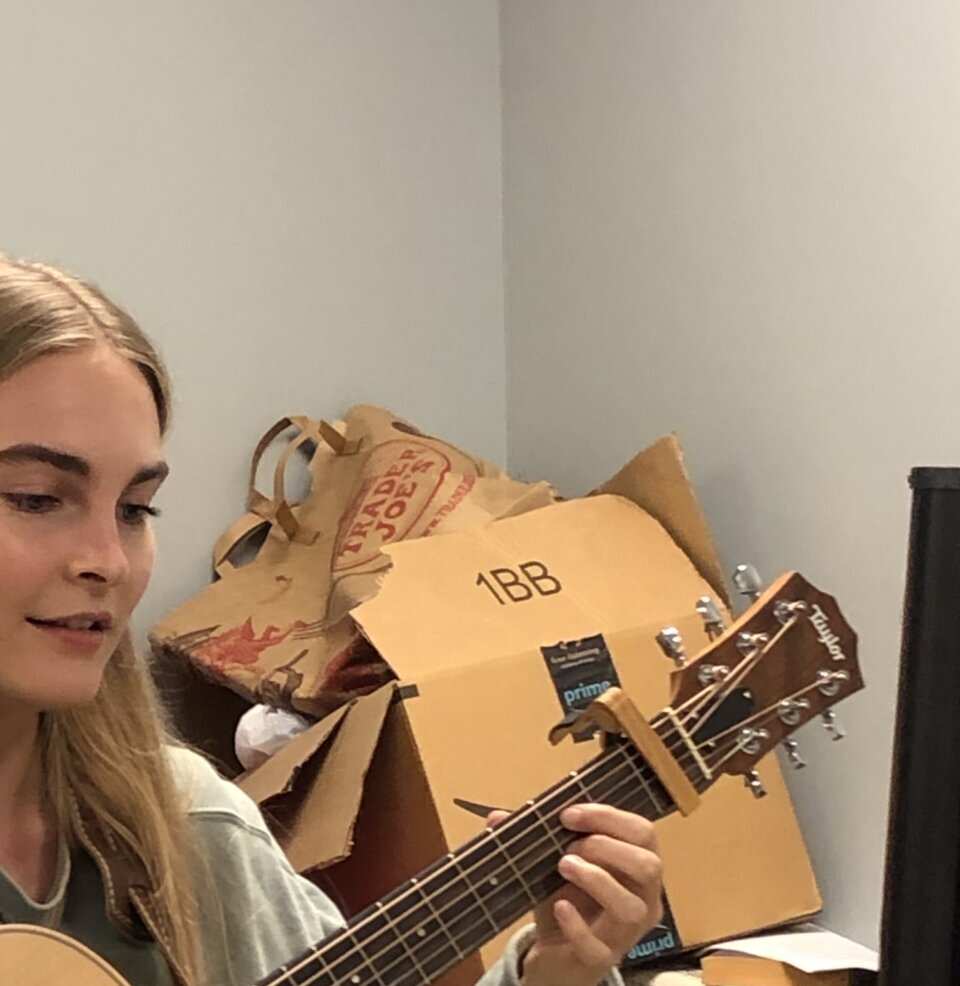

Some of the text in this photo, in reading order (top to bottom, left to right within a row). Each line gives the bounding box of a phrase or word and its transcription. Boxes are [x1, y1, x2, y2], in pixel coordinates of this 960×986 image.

[338, 449, 420, 556] TRADER
[376, 459, 435, 541] JOE'S
[476, 561, 562, 605] 1BB
[807, 603, 846, 661] Taylor
[563, 681, 611, 706] prime
[628, 931, 675, 959] prime
